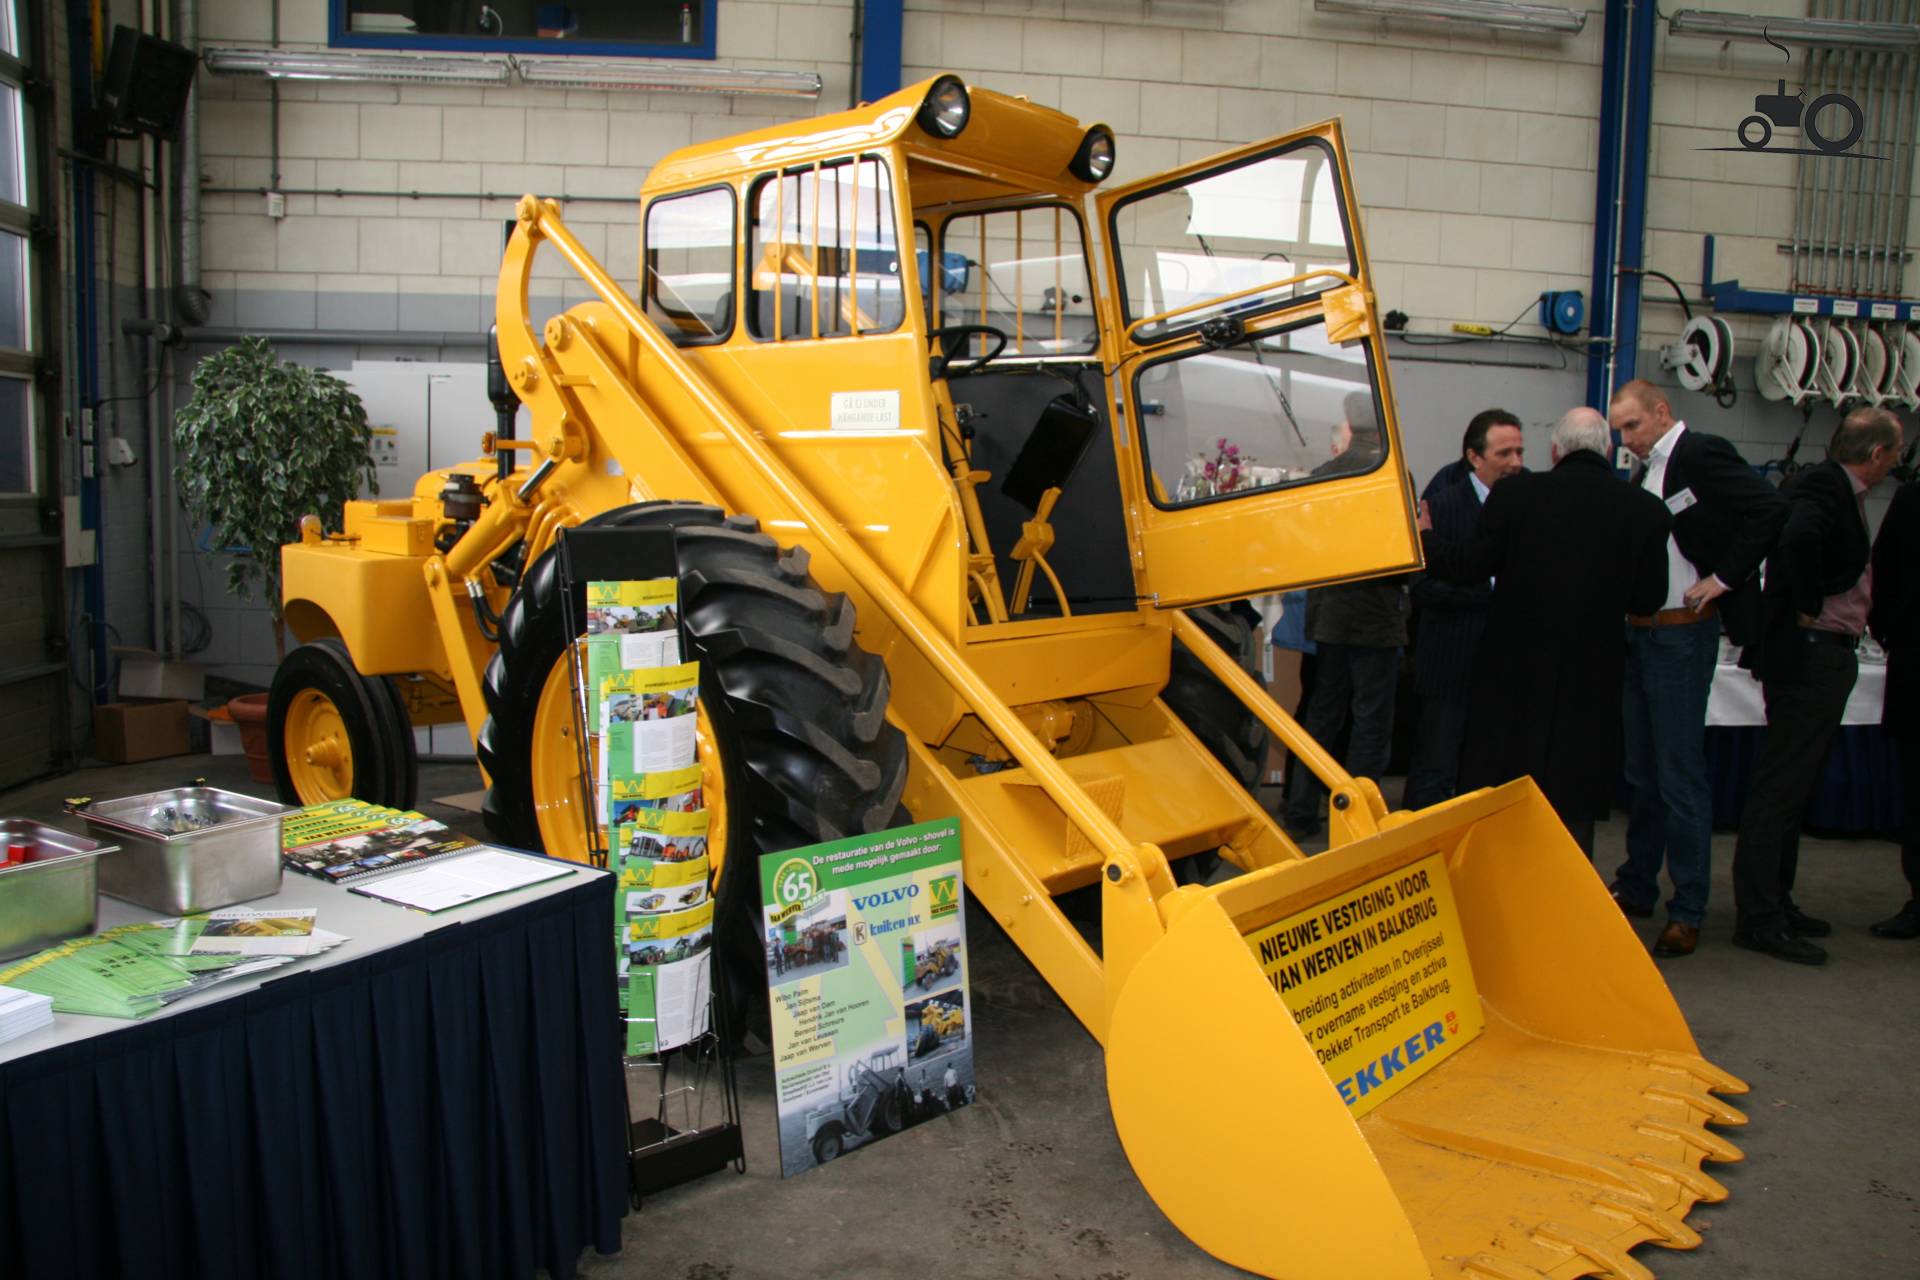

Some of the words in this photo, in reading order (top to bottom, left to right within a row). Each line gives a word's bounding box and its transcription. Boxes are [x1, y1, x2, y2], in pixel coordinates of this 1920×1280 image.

[324, 825, 362, 836] WERVEN
[813, 854, 825, 866] De
[826, 846, 868, 864] restauratie
[869, 843, 884, 852] van
[885, 840, 895, 850] de
[896, 836, 918, 848] Volvo
[924, 829, 948, 842] shovel
[949, 828, 955, 836] is
[832, 863, 854, 875] mede
[855, 854, 888, 872] mogelijk
[890, 848, 922, 864] gemaakt
[783, 872, 812, 900] 65
[852, 884, 919, 911] VOLVO
[928, 878, 958, 904] W
[870, 918, 905, 936] kuiken
[1259, 918, 1321, 965] NIEUWE
[1323, 886, 1395, 936] VESTIGING
[1395, 870, 1430, 900] VOOR
[1267, 962, 1302, 993] VAN
[1302, 934, 1364, 980] WERVEN
[1364, 928, 1378, 951] IN
[1379, 897, 1437, 942] BALKBRUG
[1293, 990, 1339, 1024] breiding
[1340, 960, 1392, 1000] activiteiten
[1393, 957, 1402, 970] in
[1402, 932, 1445, 965] Overijssel
[1316, 1002, 1366, 1040] overname
[1368, 978, 1410, 1011] vestiging
[1410, 970, 1421, 982] en
[1422, 956, 1447, 979] activa
[1445, 1010, 1457, 1024] B
[1448, 1023, 1459, 1035] V
[809, 1040, 832, 1052] Werven
[1316, 1034, 1353, 1065] Dekker
[1354, 1009, 1400, 1043] Transport
[1402, 1000, 1411, 1016] te
[1336, 1020, 1446, 1106] EKKER
